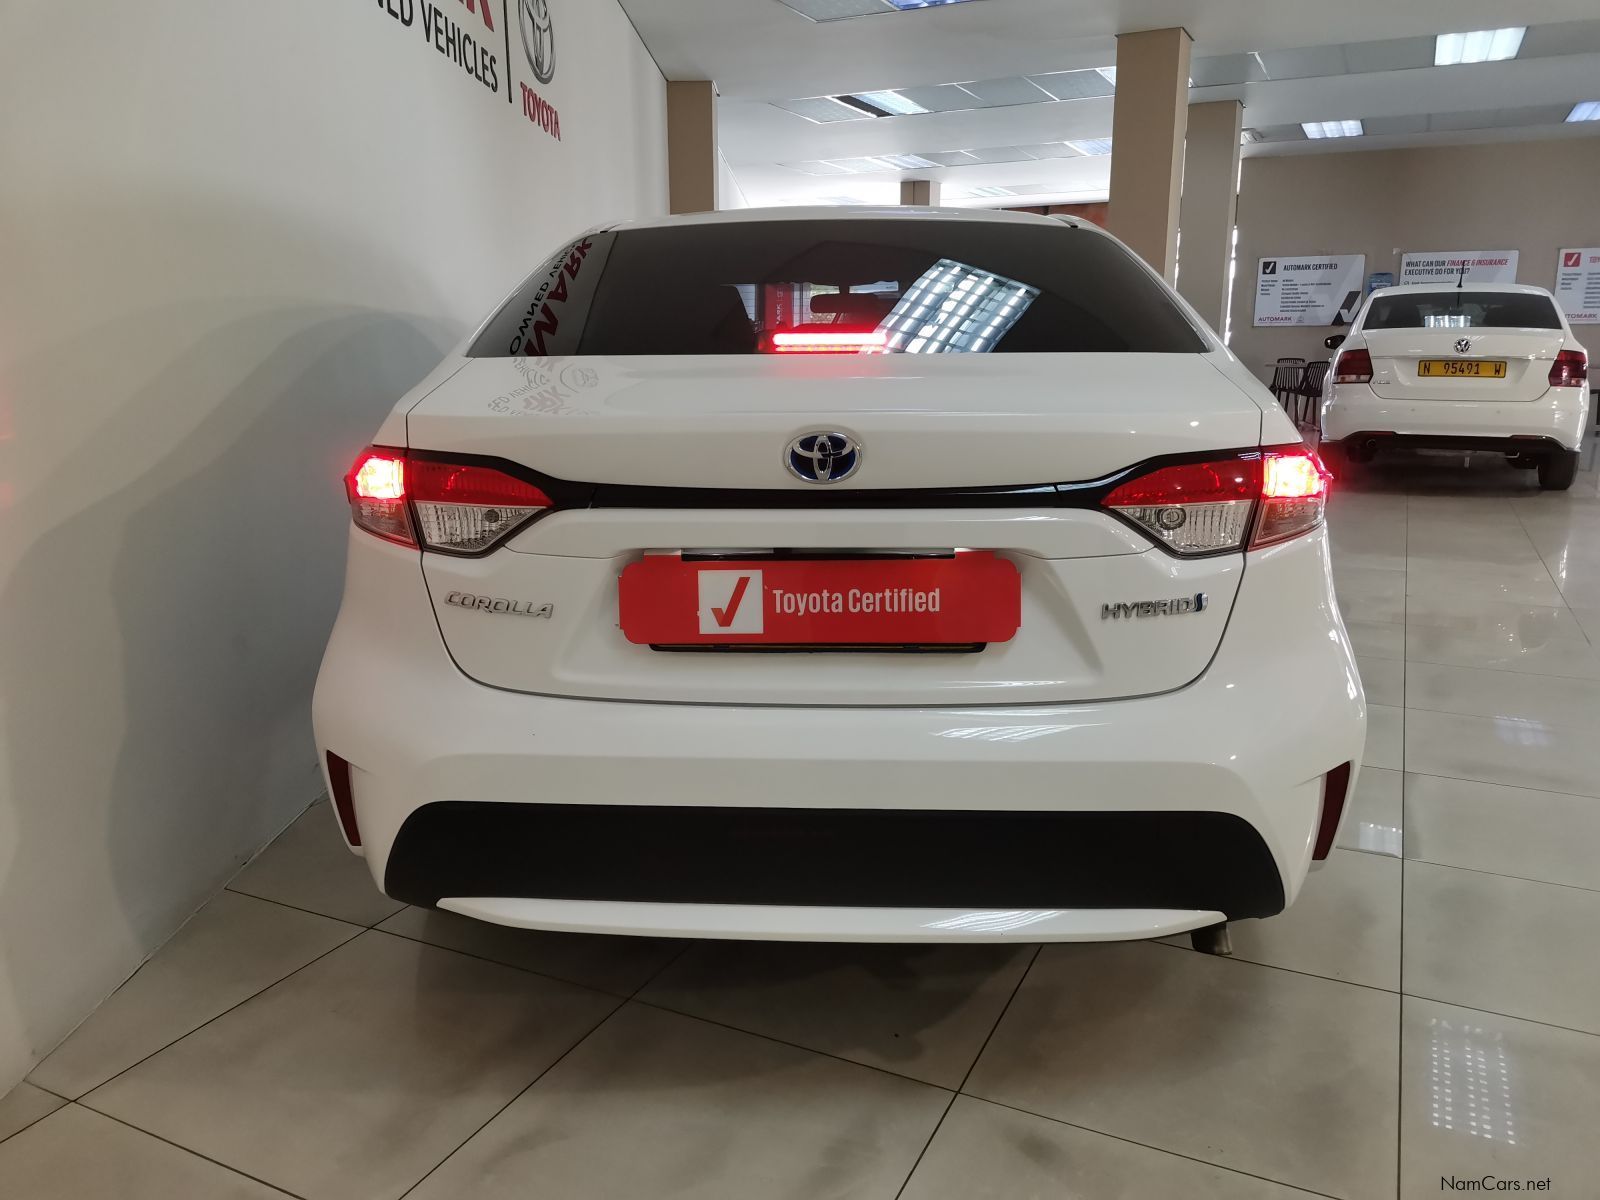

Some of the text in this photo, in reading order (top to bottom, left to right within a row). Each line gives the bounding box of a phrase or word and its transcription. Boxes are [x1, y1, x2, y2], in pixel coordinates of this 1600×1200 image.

[420, 0, 498, 93] VEHICLES
[520, 81, 561, 142] TOYOTA
[1283, 263, 1338, 272] AUTOMARK CERTIFIED
[1404, 268, 1434, 276] EXECUTIVE
[1405, 260, 1421, 268] WHAT
[1422, 260, 1434, 268] CAN
[1446, 259, 1470, 267] FINANCE
[1423, 362, 1502, 375] N 95491 W
[444, 591, 553, 619] COROLLA
[772, 588, 940, 616] Toyota Certified
[1100, 598, 1192, 620] HYBRID
